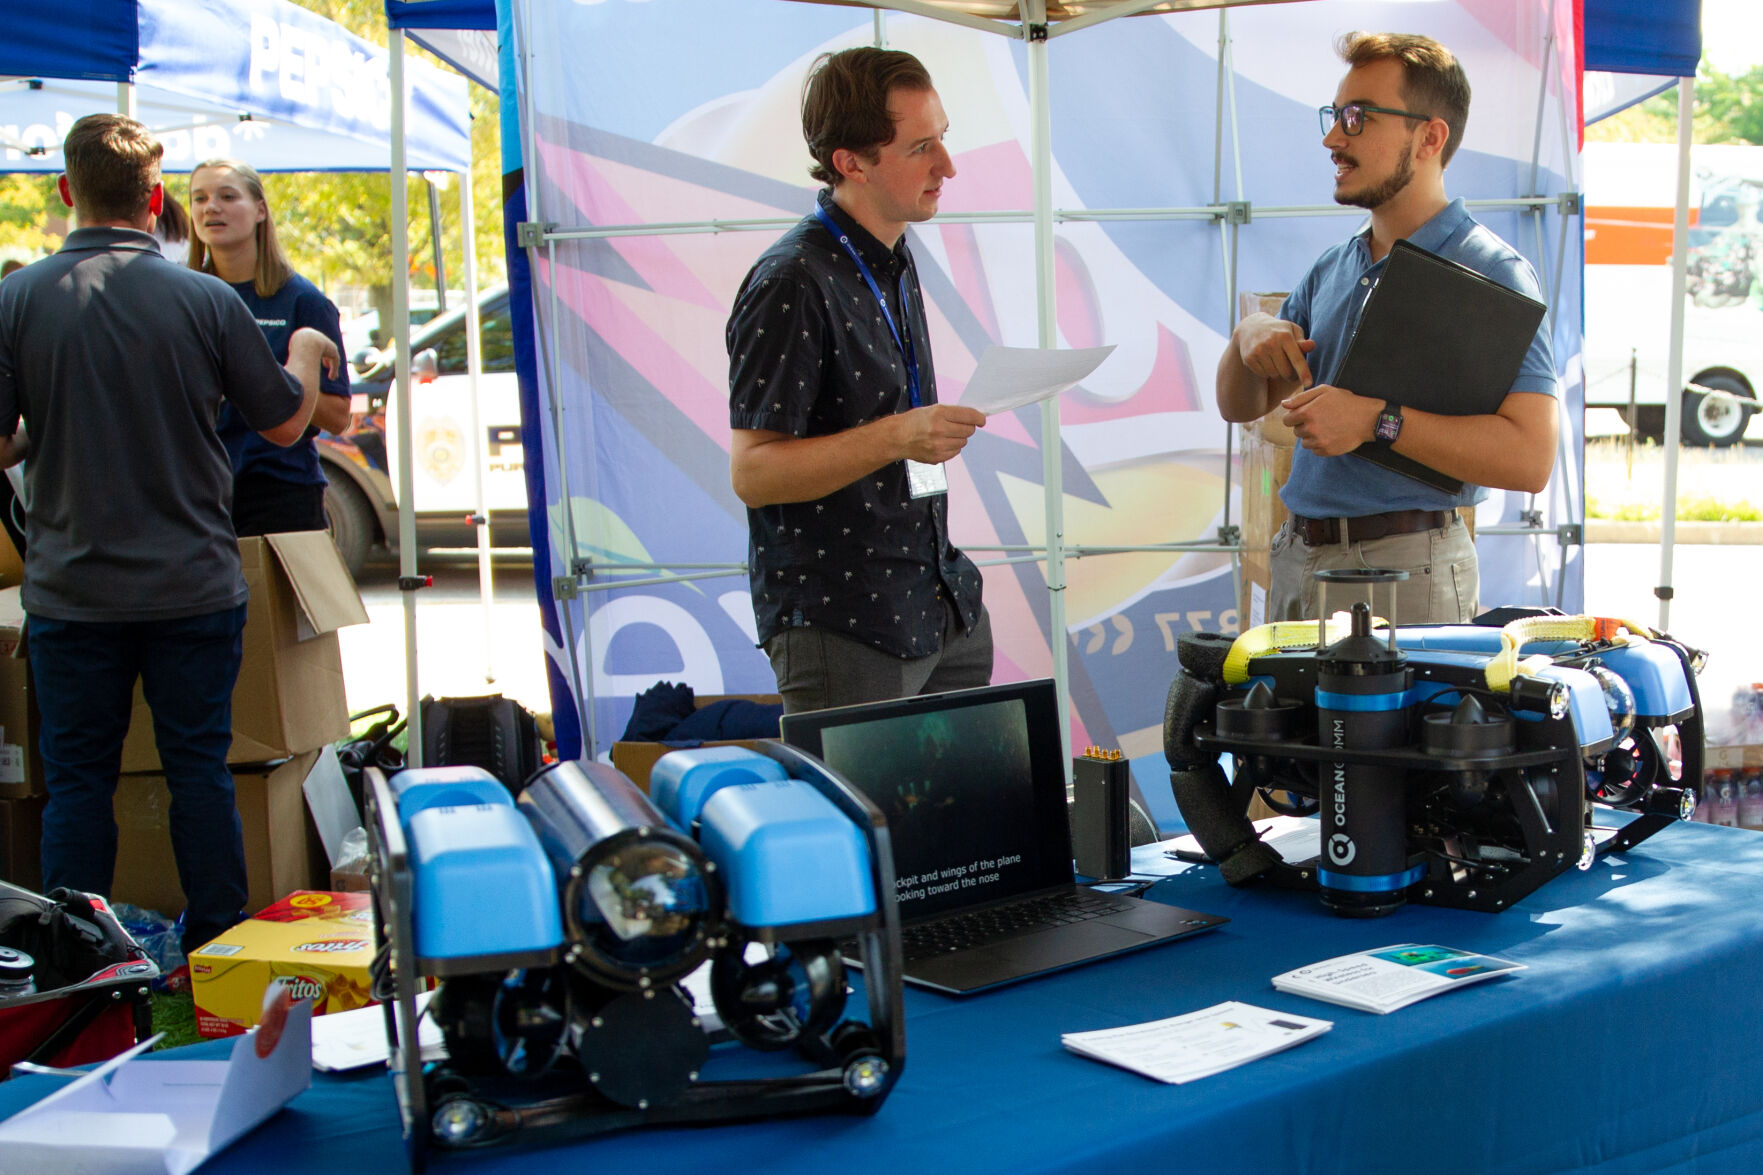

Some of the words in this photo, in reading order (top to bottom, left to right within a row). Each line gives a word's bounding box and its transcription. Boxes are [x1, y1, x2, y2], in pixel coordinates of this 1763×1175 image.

[921, 870, 938, 883] and
[940, 864, 967, 878] wings
[969, 861, 978, 872] of
[980, 859, 995, 871] the
[997, 853, 1022, 868] plane
[927, 879, 960, 896] toward
[961, 876, 977, 888] the
[978, 872, 1000, 885] nose
